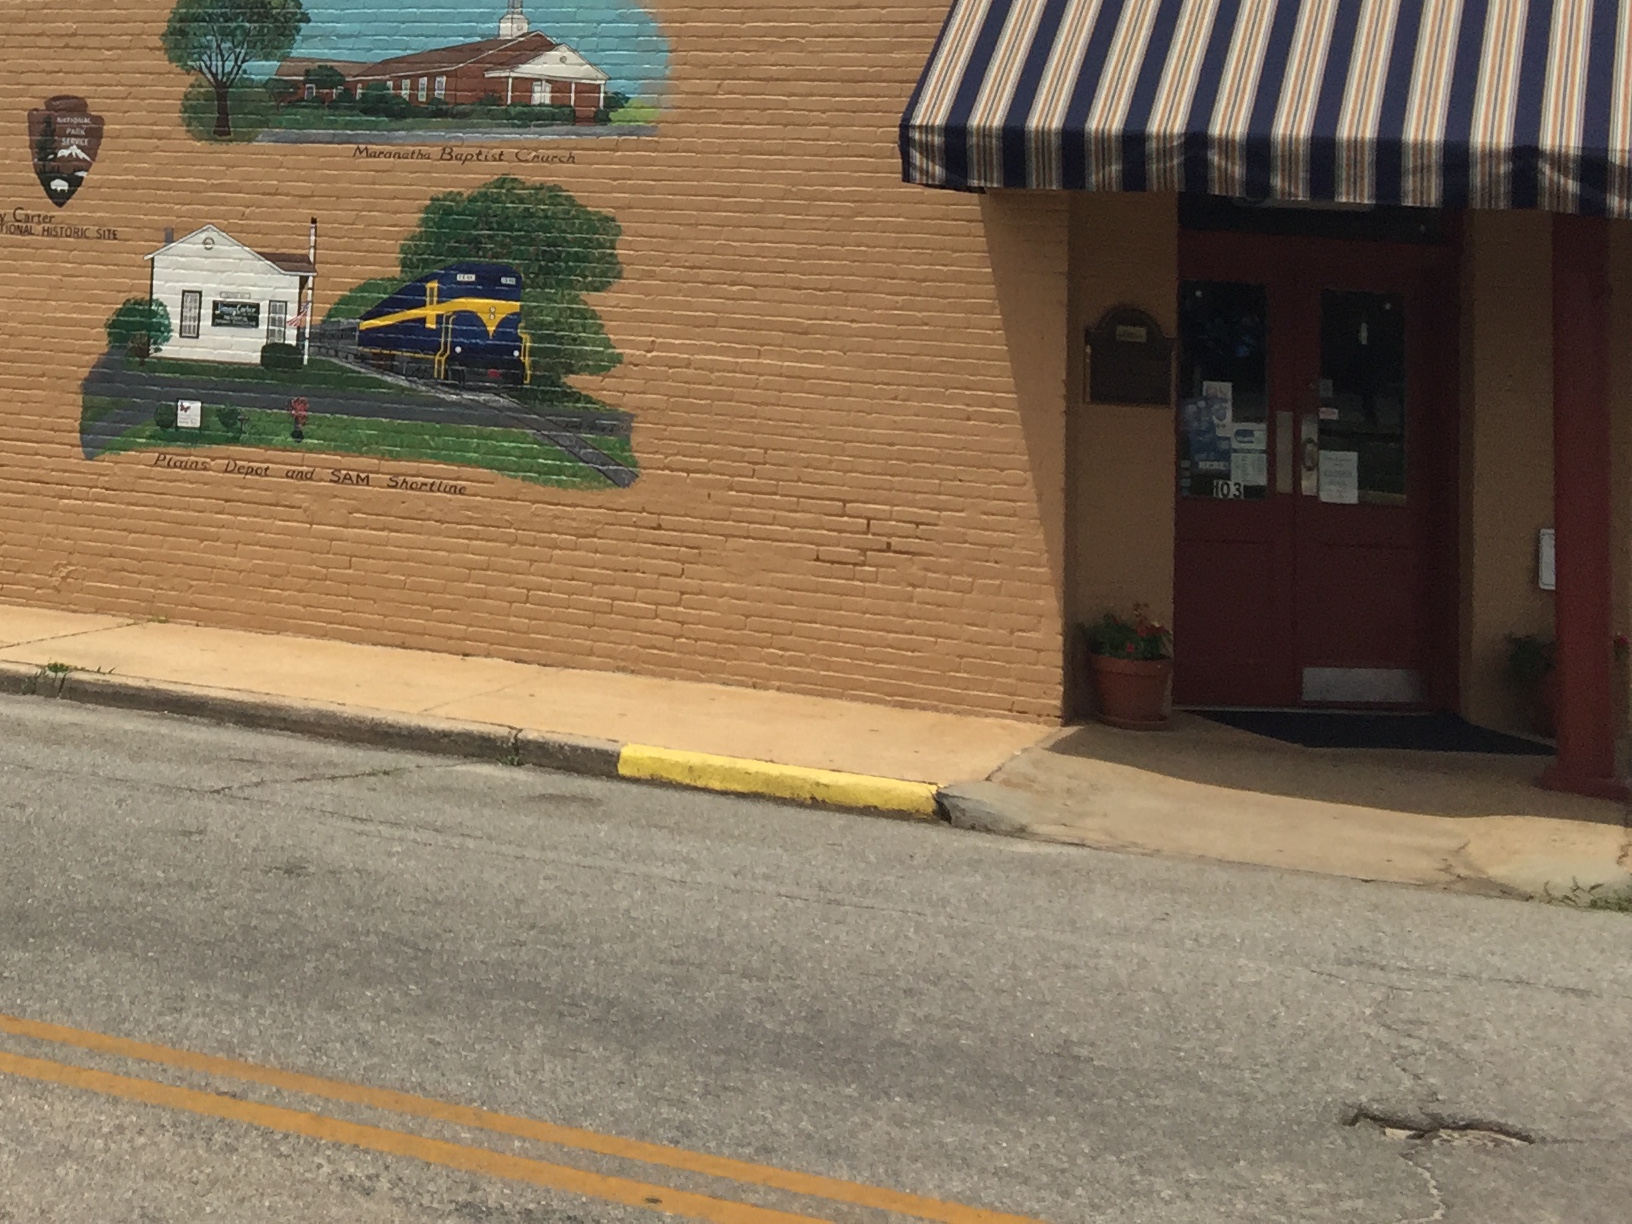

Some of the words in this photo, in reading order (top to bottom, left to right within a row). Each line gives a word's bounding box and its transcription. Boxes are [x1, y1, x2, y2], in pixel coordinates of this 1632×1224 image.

[352, 145, 432, 161] Maranatha
[439, 146, 505, 166] Baptist
[12, 207, 56, 225] Carter
[41, 226, 91, 240] HISTORIC
[95, 228, 119, 241] SITE
[153, 453, 209, 472] Plains
[224, 459, 271, 480] Depot
[284, 467, 316, 482] and
[328, 470, 371, 486] SAM
[386, 475, 468, 496] Shortline
